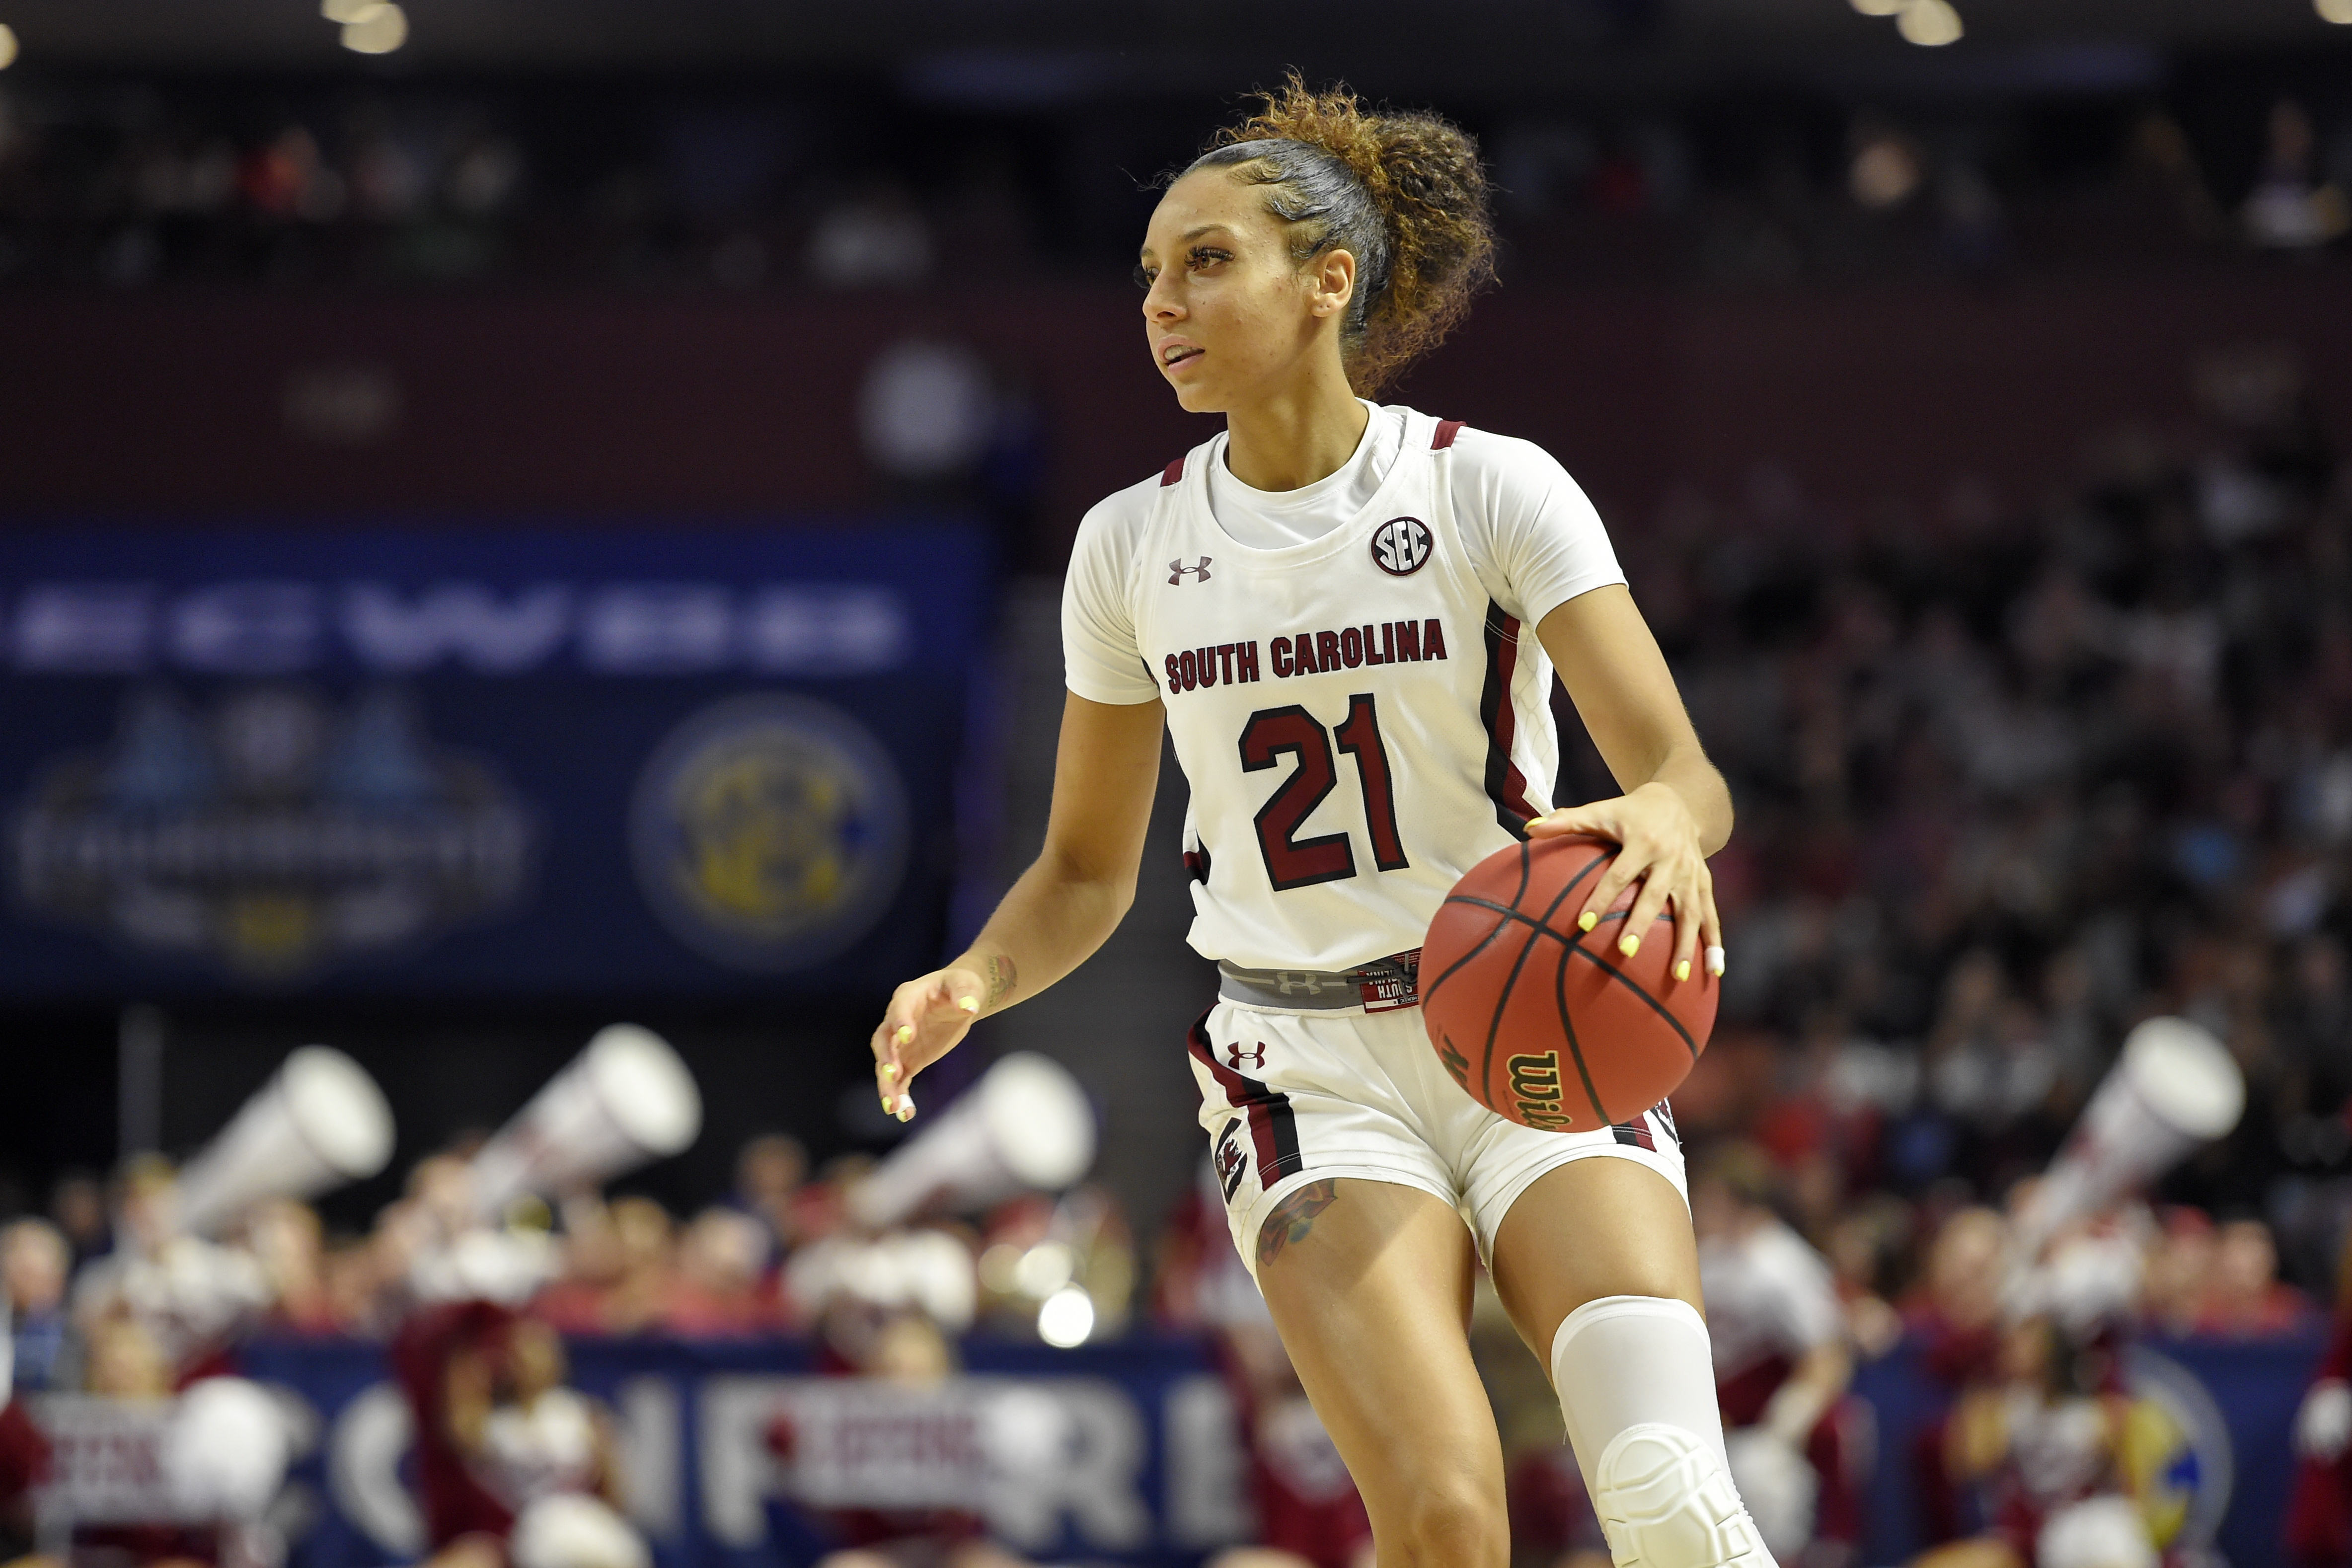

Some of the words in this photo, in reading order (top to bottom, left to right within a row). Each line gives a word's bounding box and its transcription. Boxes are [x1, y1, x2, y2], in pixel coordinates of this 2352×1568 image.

[1376, 522, 1427, 571] SEC
[1165, 641, 1260, 694] SOUTH
[1270, 619, 1447, 677] CAROLINA
[1238, 693, 1410, 892] 21
